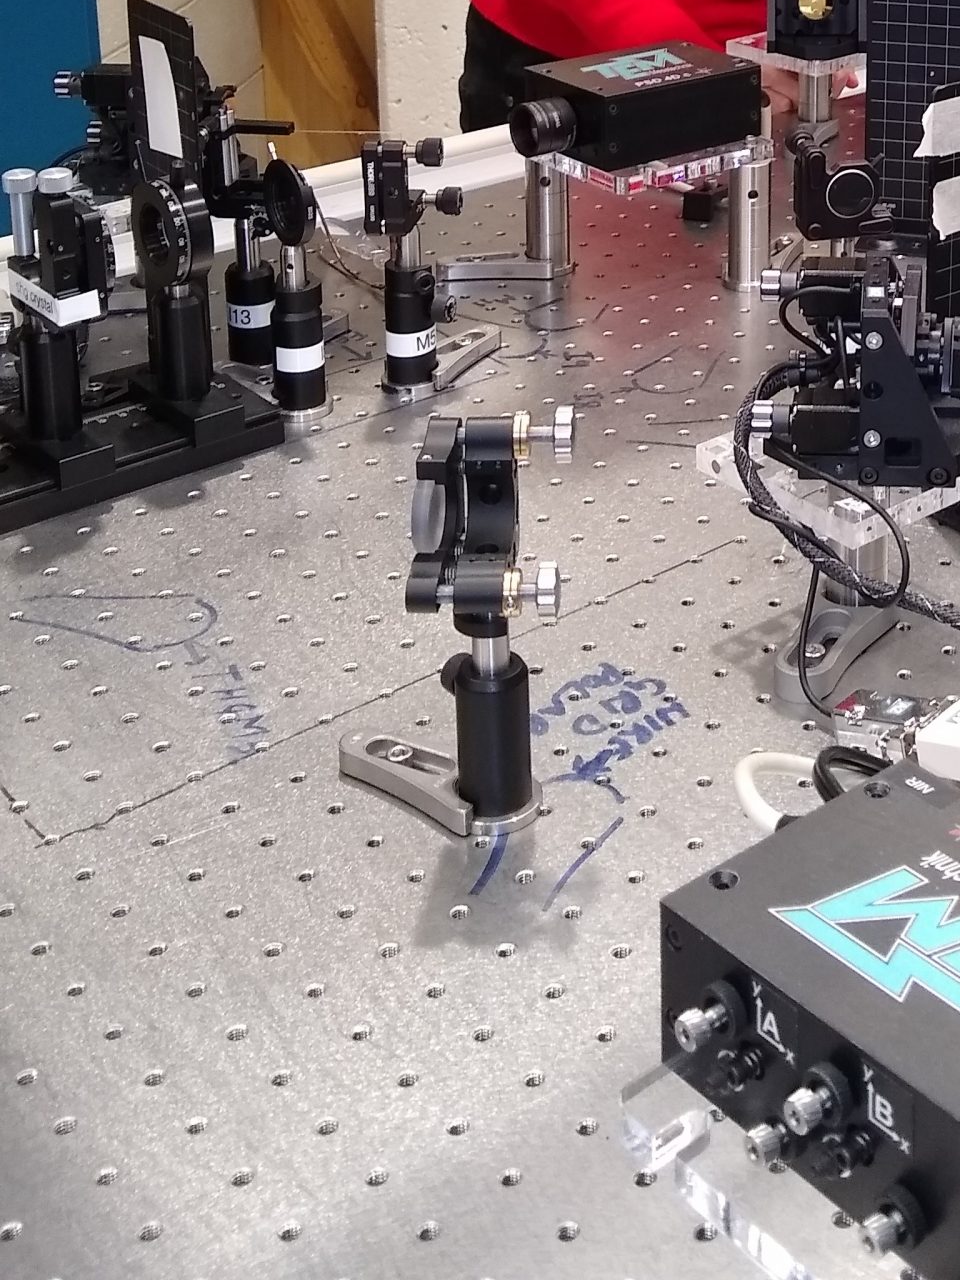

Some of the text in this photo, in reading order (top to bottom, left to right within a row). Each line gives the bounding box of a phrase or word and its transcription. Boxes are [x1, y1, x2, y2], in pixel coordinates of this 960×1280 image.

[580, 48, 686, 81] TEM
[904, 776, 935, 794] NIR
[762, 1011, 781, 1042] A
[874, 1094, 895, 1128] B
